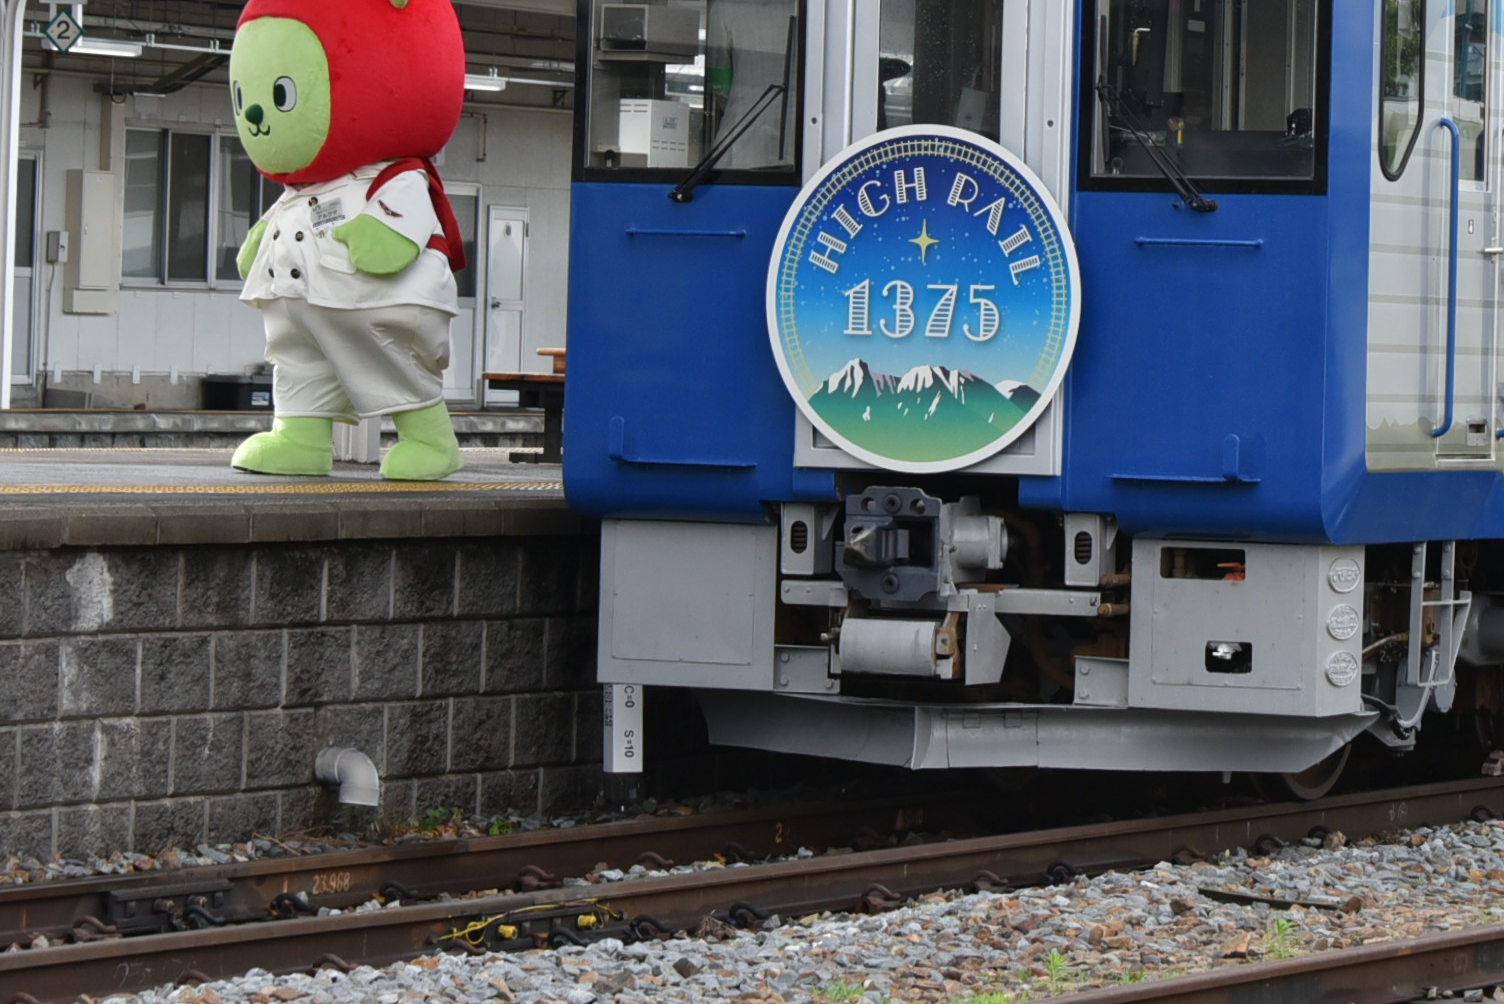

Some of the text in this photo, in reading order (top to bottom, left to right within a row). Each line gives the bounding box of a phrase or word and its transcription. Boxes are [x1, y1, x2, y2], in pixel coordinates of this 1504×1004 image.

[56, 20, 71, 40] 2
[808, 166, 1042, 286] HIGH RAIL
[843, 278, 1001, 342] 1375
[624, 685, 635, 758] C=0 S=10
